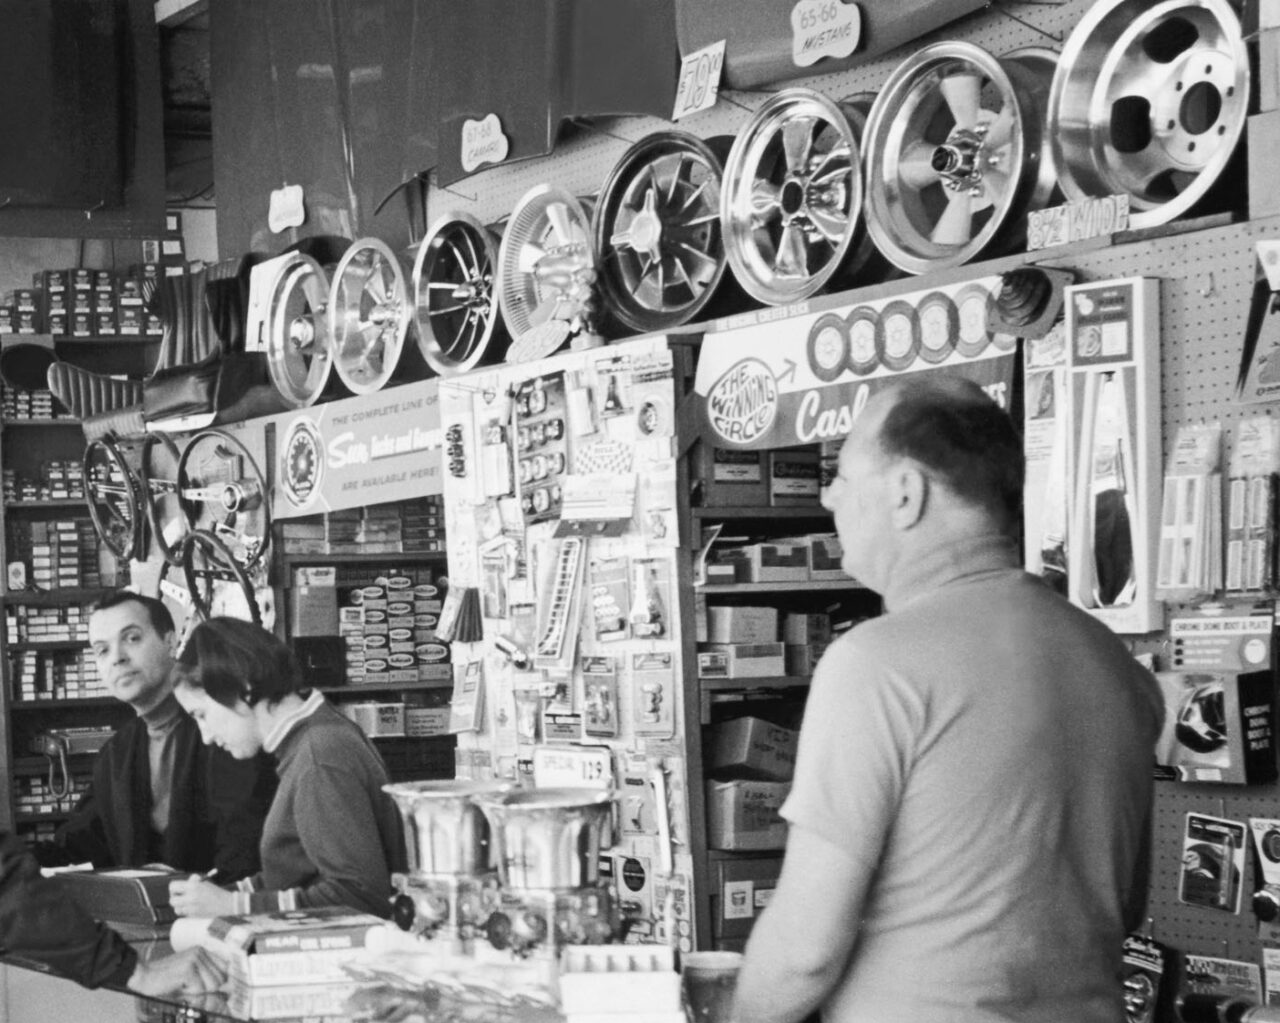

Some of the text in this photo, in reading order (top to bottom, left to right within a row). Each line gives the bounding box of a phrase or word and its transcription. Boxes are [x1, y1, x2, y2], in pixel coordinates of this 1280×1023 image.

[801, 22, 852, 51] MUSTANG
[720, 363, 749, 392] THE
[332, 394, 439, 425] THE COMPLETE LINE OF
[342, 481, 359, 491] ARE
[362, 473, 406, 489] AVAILABLE
